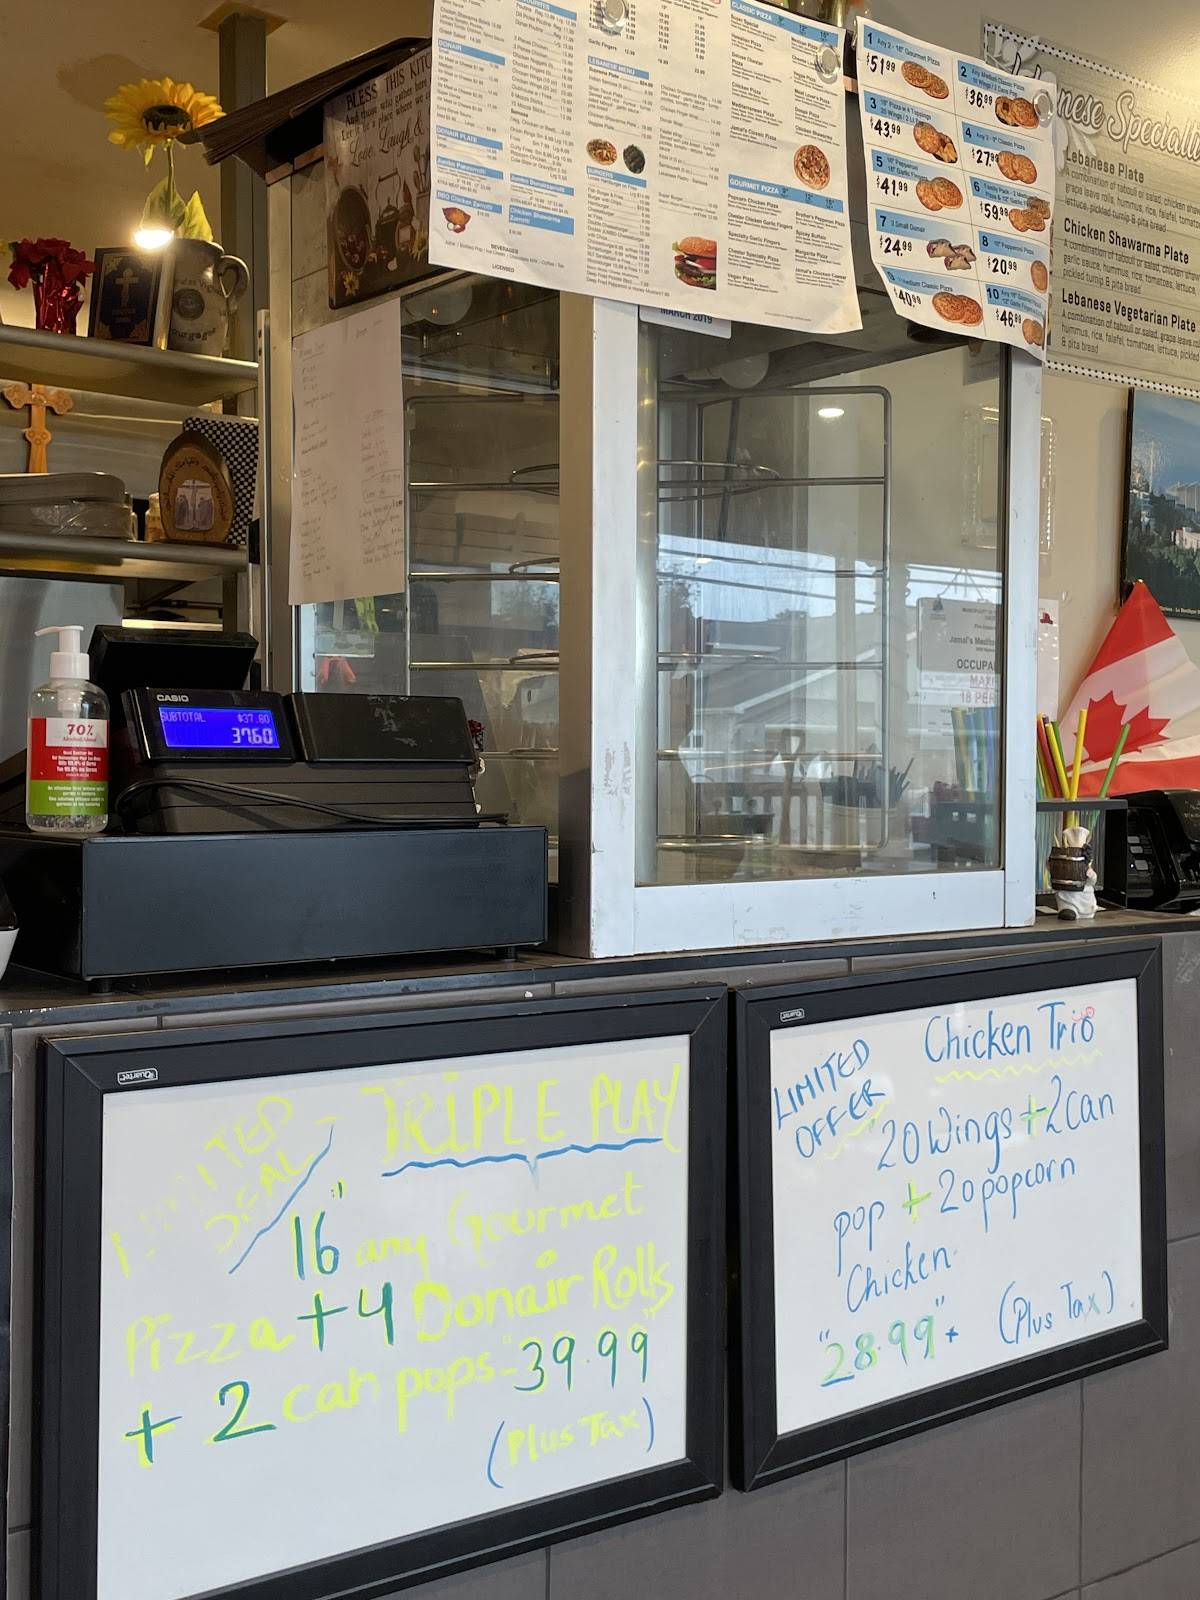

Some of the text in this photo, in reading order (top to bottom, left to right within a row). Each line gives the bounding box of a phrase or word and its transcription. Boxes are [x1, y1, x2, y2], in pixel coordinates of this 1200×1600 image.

[755, 9, 772, 21] PIZZA
[867, 32, 873, 45] 1
[960, 66, 967, 77] 2
[345, 52, 431, 111] BLESS THIS KITC
[870, 97, 877, 109] 3
[437, 126, 478, 142] DONAIR PLATE
[870, 116, 901, 139] $43.99
[965, 127, 972, 138] 4
[876, 156, 883, 167] 5
[1065, 147, 1145, 184] Lebanese Plate
[729, 178, 780, 194] GOURMET PIZZA
[876, 175, 908, 197] $41.99
[973, 181, 980, 192] 6
[766, 201, 779, 209] Pizza
[880, 215, 886, 227] 7
[490, 243, 519, 255] BEVERAGES
[880, 235, 912, 257] $24.99
[982, 235, 989, 247] 8
[1063, 217, 1189, 265] Chicken Shawarma Plate
[987, 256, 1017, 276] $20.99
[986, 287, 999, 300] 10
[1062, 287, 1196, 333] Lebanese Vegetarian Plate
[949, 635, 974, 645] Jamal's
[956, 658, 994, 670] OCCUPA
[970, 675, 994, 686] MAXI
[156, 694, 189, 702] CASIO
[960, 691, 972, 703] 18
[160, 711, 206, 723] SUBTOTAL
[67, 724, 94, 736] 70%
[925, 1001, 1095, 1062] Chicken Trio
[773, 1039, 870, 1130] LIMITED
[360, 1062, 682, 1164] TRIPLE PLAY
[796, 1079, 886, 1158] OFFER
[928, 1107, 1012, 1175] Wings
[833, 1201, 884, 1277] pop
[982, 1156, 1075, 1233] popcorn
[356, 1234, 431, 1282] any
[847, 1241, 951, 1313] Chicken
[125, 1312, 296, 1376] Pizza
[412, 1249, 584, 1344] Donair
[592, 1240, 676, 1311] Rolls
[999, 1280, 1052, 1344] (Plus
[1060, 1270, 1114, 1321] Tax)
[203, 1380, 277, 1445] 2
[282, 1366, 381, 1423] can
